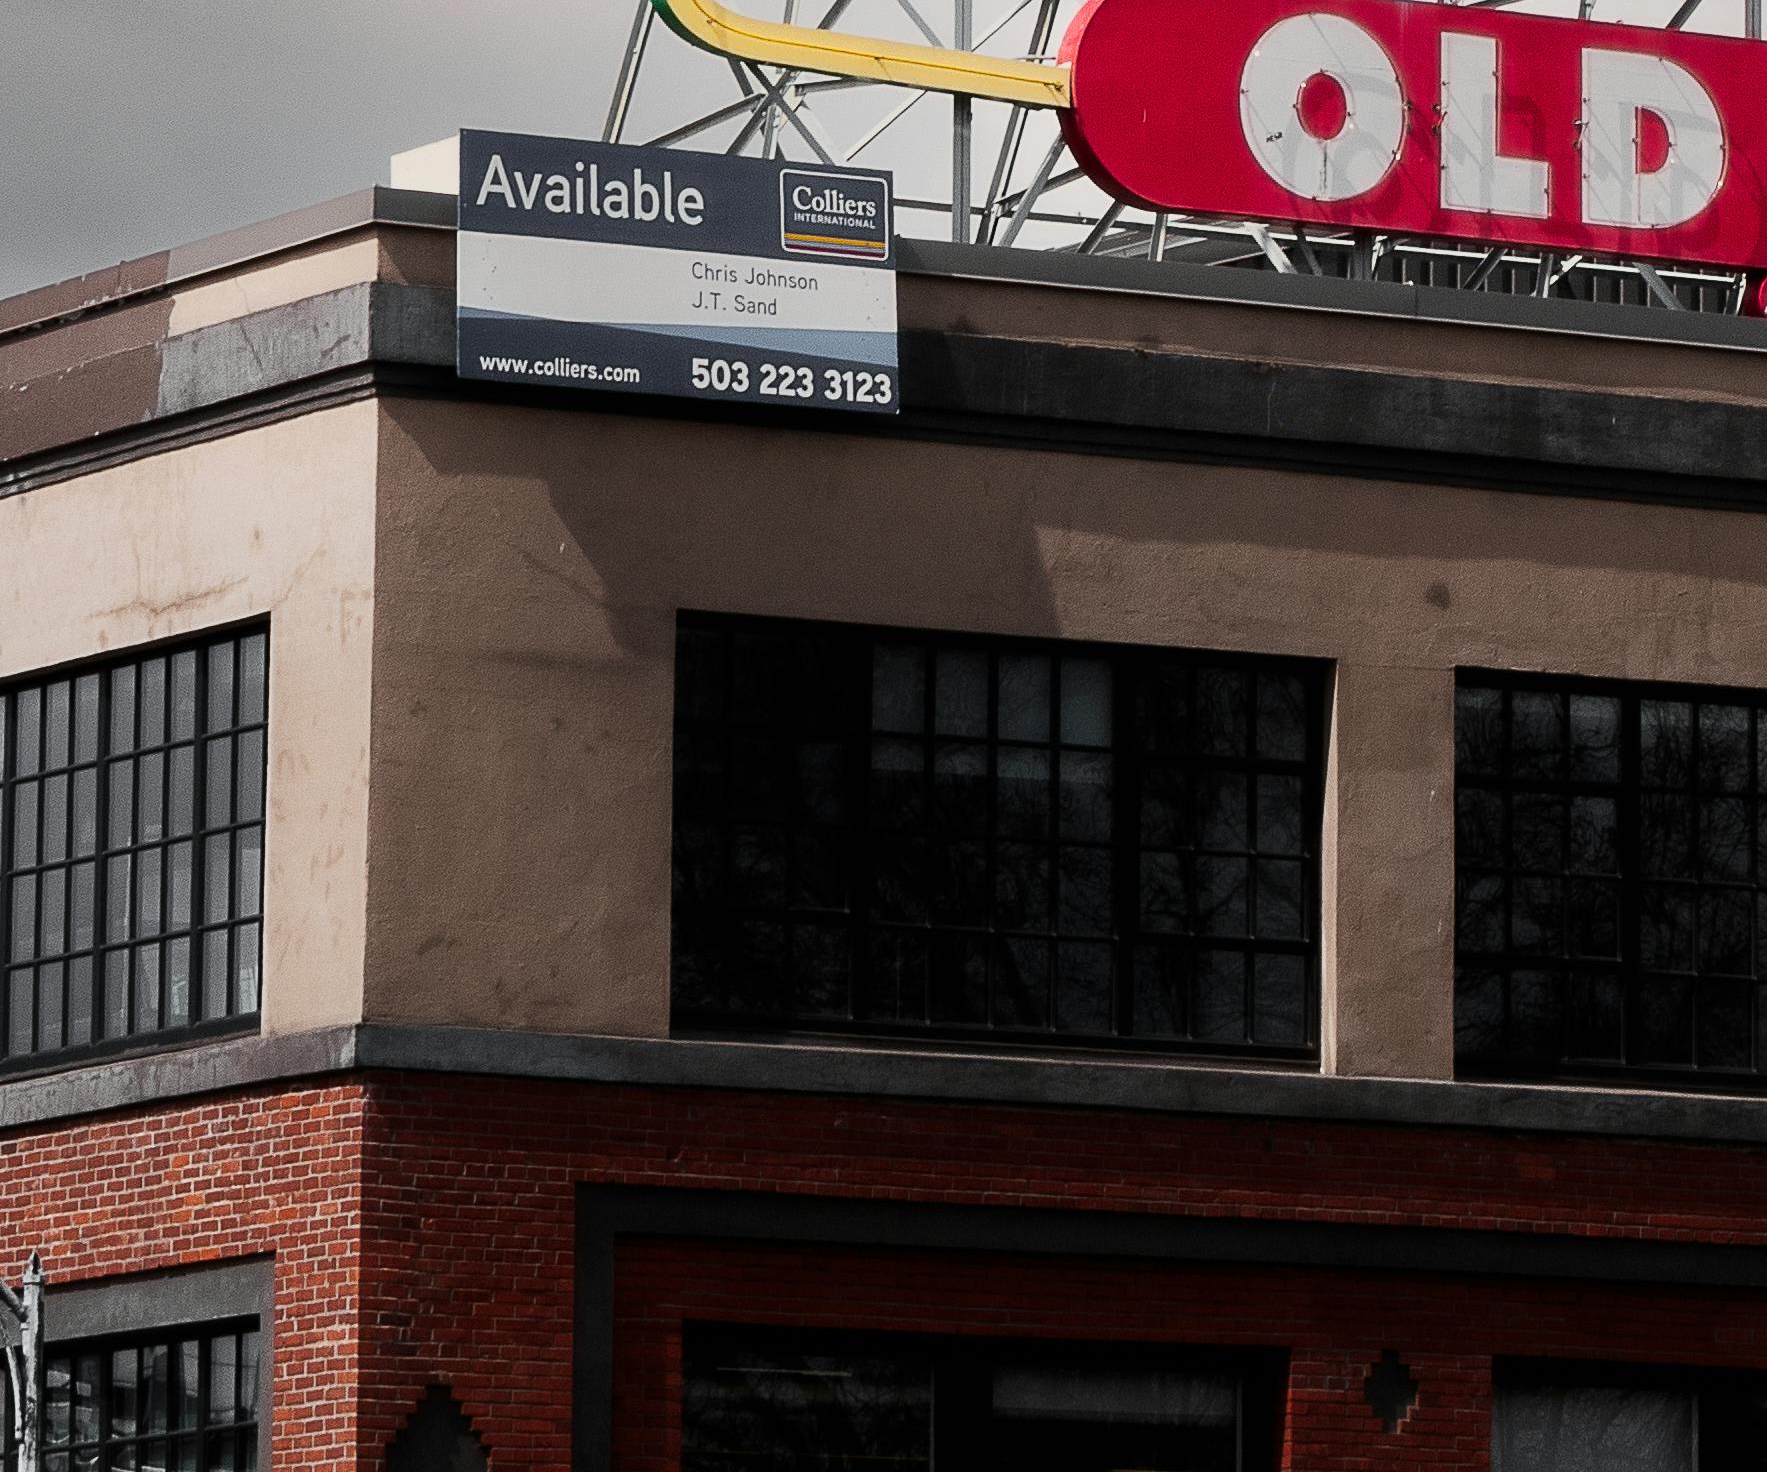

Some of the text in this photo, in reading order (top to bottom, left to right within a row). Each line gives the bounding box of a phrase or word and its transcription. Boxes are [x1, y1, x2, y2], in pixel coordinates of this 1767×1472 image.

[1239, 13, 1729, 229] OLD
[476, 154, 704, 225] Available
[792, 185, 877, 217] Colliers
[793, 212, 877, 230] INTERNATIONAL
[691, 261, 819, 291] Chris Johnson
[691, 290, 778, 316] J.T. Sand
[479, 355, 641, 384] www.colliers.com
[691, 357, 893, 405] 503 223 3123
